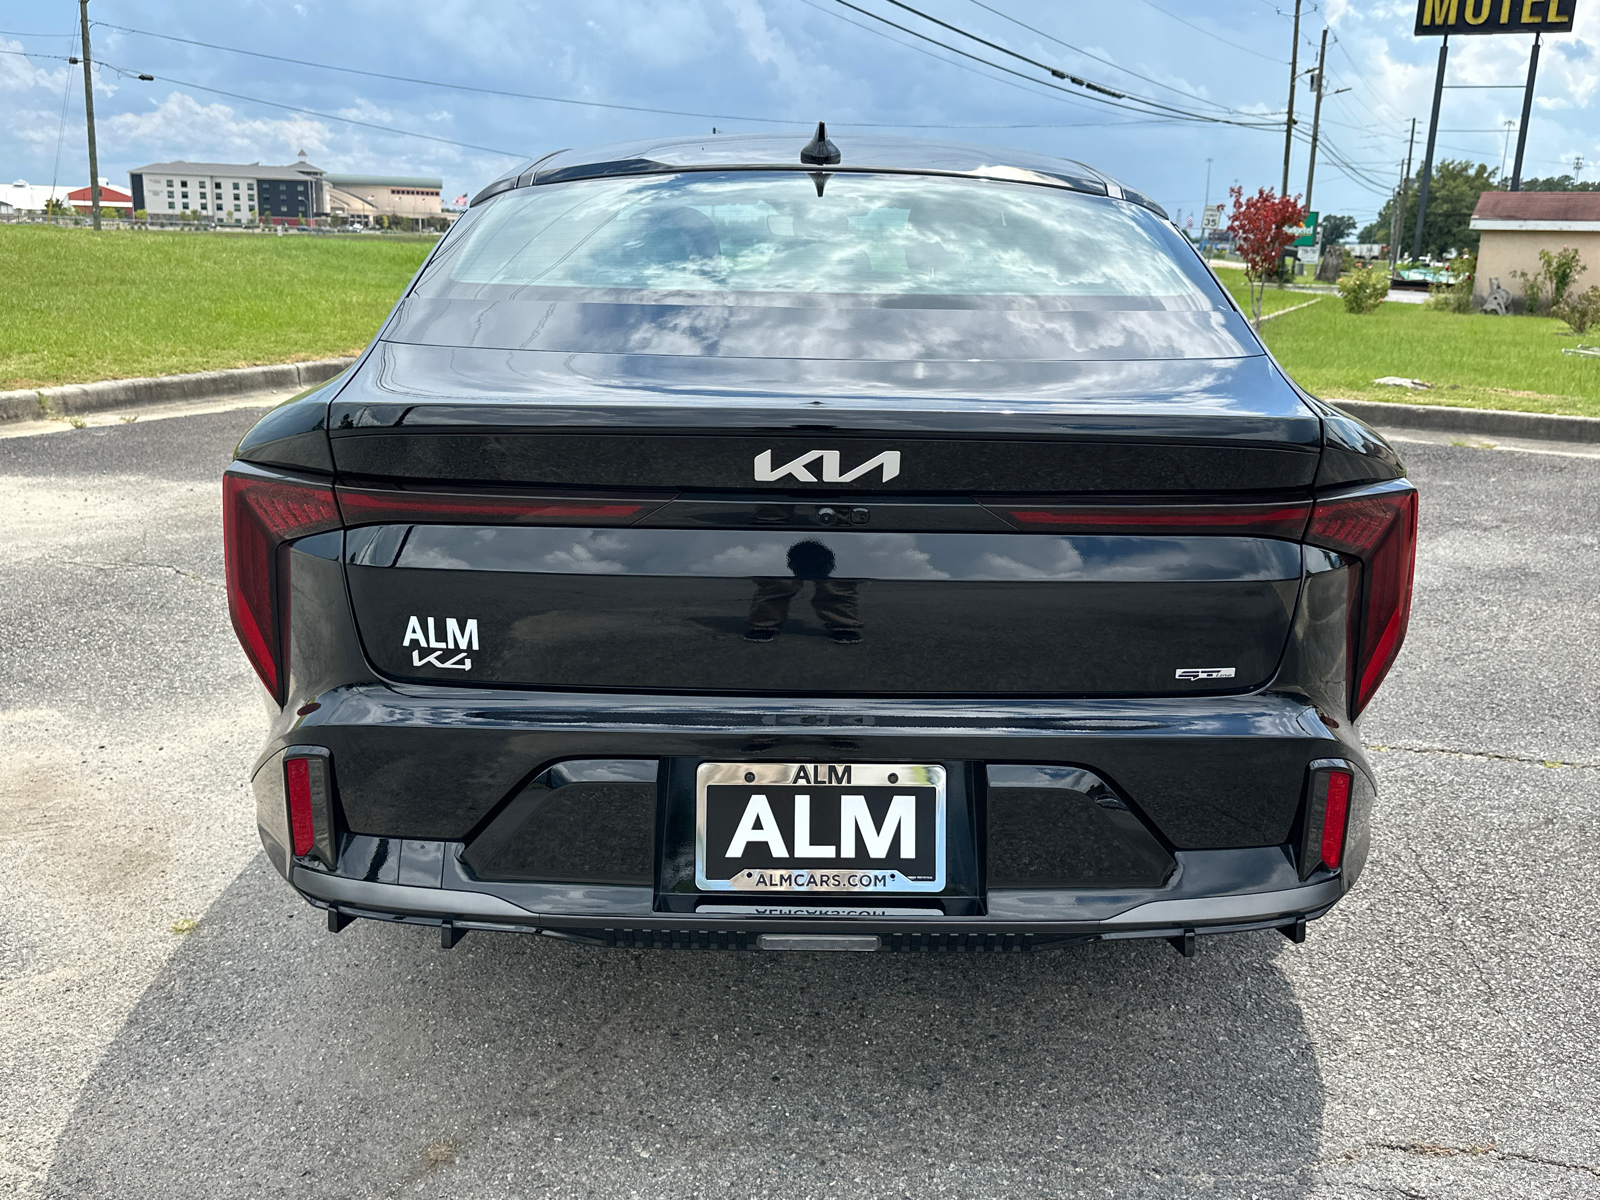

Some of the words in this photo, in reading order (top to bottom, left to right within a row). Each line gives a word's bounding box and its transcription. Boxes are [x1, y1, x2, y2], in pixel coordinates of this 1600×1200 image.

[1204, 218, 1217, 227] 35
[754, 449, 901, 483] KIA
[402, 615, 479, 650] ALM
[792, 764, 852, 784] ALM
[724, 794, 916, 859] ALM
[756, 874, 886, 887] ALMCARS.COM
